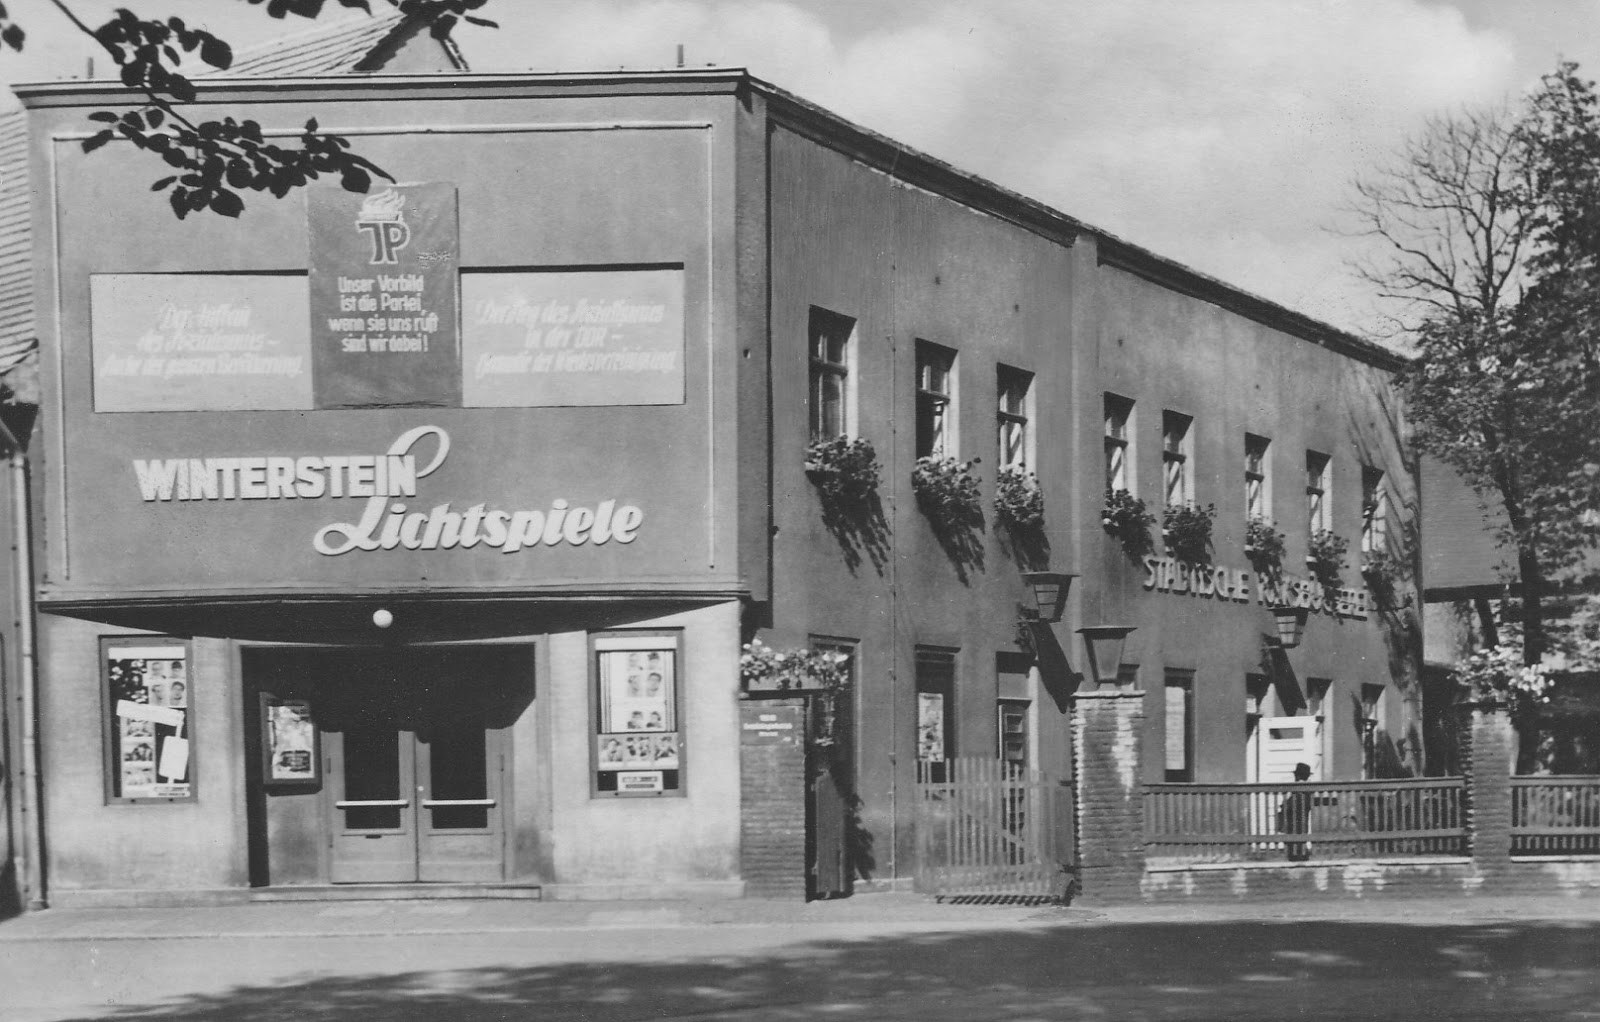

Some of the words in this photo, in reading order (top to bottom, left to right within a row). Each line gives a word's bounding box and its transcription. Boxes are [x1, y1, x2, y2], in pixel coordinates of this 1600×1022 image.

[338, 276, 376, 293] Unser
[377, 274, 424, 292] Vorbild
[340, 294, 357, 311] ist
[358, 294, 377, 311] die
[327, 317, 365, 331] wenn
[367, 313, 386, 331] sie
[388, 317, 412, 331] uns
[341, 333, 367, 352] sind
[369, 333, 388, 352] wir
[133, 454, 417, 501] WINTERSTEIN
[312, 496, 644, 556] Lichtspiele
